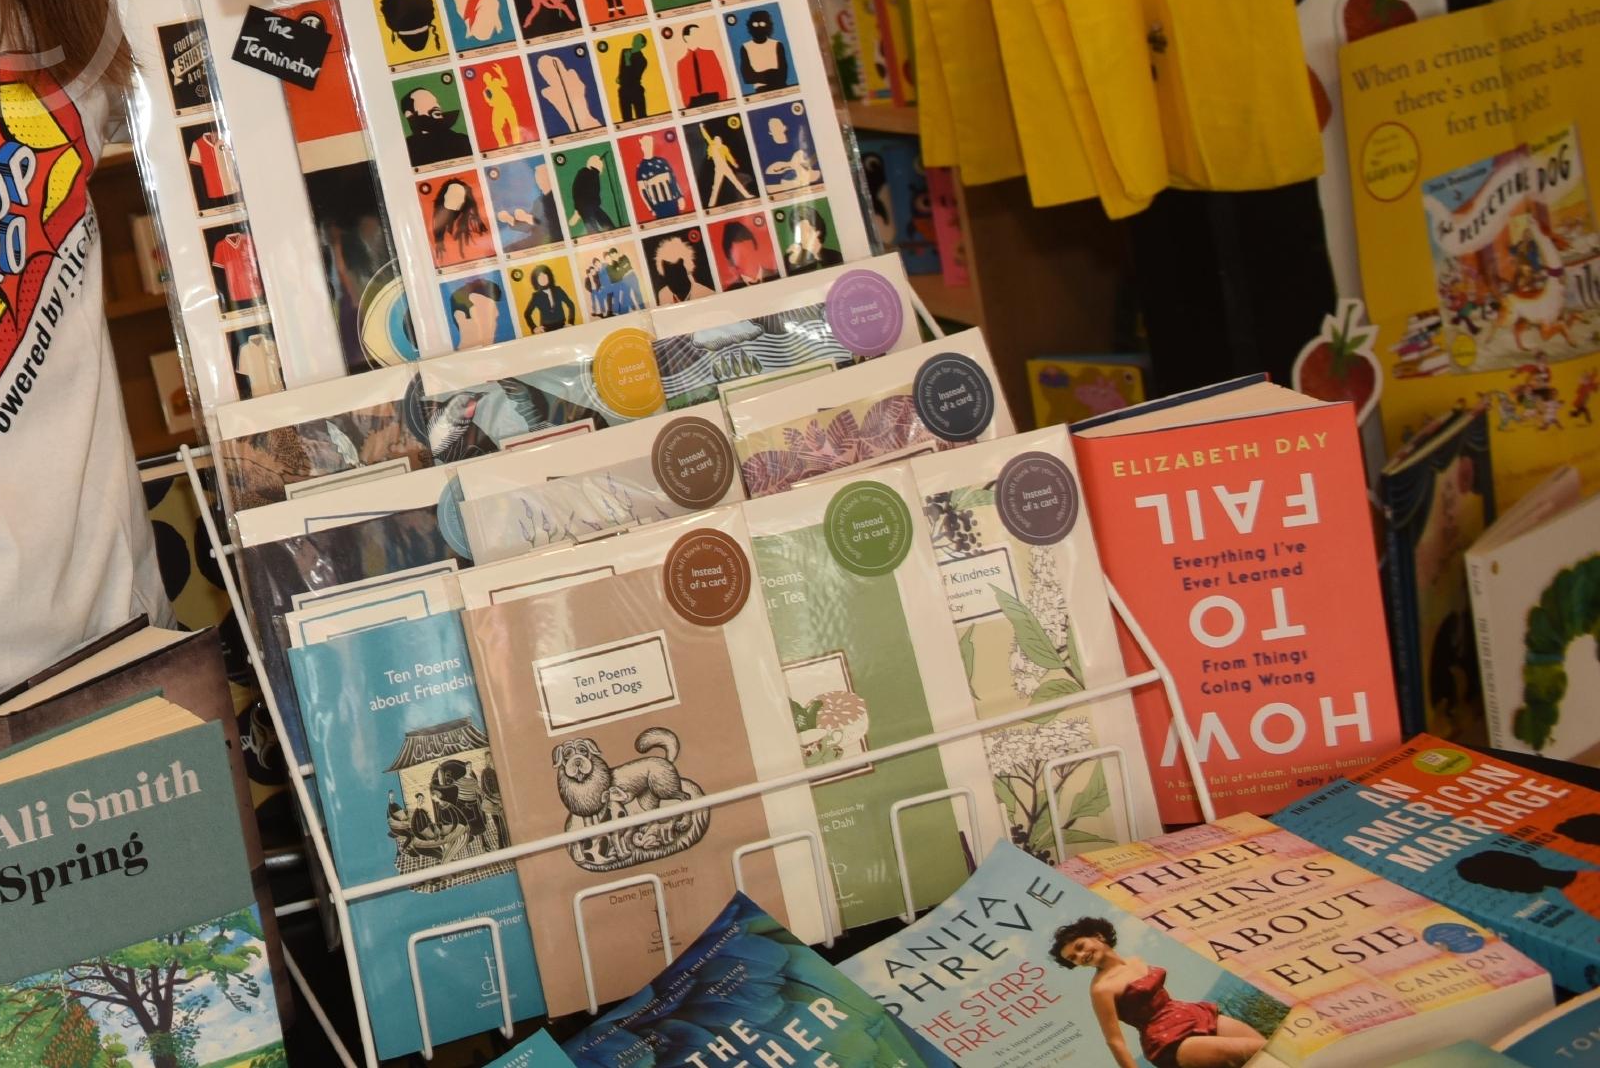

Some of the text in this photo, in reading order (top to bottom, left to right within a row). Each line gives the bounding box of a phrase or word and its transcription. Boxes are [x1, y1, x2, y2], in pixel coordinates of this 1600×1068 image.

[264, 16, 295, 40] The
[241, 35, 321, 79] Terminator
[1351, 62, 1411, 92] When
[1433, 39, 1496, 70] crime
[1394, 78, 1465, 115] there's
[1551, 45, 1585, 70] dog
[1446, 109, 1477, 137] for
[1536, 142, 1571, 194] DOG
[40, 288, 65, 328] by
[617, 360, 646, 375] Instead
[635, 370, 651, 383] card
[938, 383, 966, 400] Instead
[956, 392, 973, 406] card
[678, 447, 707, 467] Instead
[680, 457, 713, 478] of card
[1111, 431, 1329, 478] ELIZABETH DAY
[1022, 484, 1052, 500] Instead
[1022, 495, 1059, 512] of card
[852, 513, 884, 530] Instead
[1134, 472, 1322, 546] FAIL
[701, 541, 713, 550] for
[852, 524, 890, 543] of card
[1172, 540, 1308, 572] Everything I've
[689, 574, 727, 590] of card
[691, 564, 722, 578] Instead
[950, 564, 1002, 585] Kindness
[1181, 562, 1305, 592] Ever Learned
[781, 589, 807, 605] Tea
[1188, 586, 1307, 649] TO
[383, 656, 462, 686] Ten Poems
[573, 663, 638, 689] Ten Poems
[1202, 648, 1309, 675] From Things
[574, 678, 643, 705] about Dogs
[1200, 668, 1317, 698] Going Wrong
[368, 689, 411, 712] about
[1159, 691, 1373, 768] HOW
[1231, 772, 1244, 782] of
[1236, 774, 1325, 797] and Dolly
[1292, 783, 1349, 816] THE NEW YORK
[1356, 778, 1421, 810] AN
[831, 816, 856, 832] Dahl
[1343, 763, 1523, 858] AMERICAN
[1386, 778, 1573, 874] MARRIAGE
[663, 874, 696, 892] Murray
[1106, 840, 1277, 899] THREE
[477, 903, 514, 919] Introduced
[609, 891, 636, 907] Dame
[1141, 861, 1337, 932] THINGS
[884, 895, 1008, 980] ANITA
[1206, 888, 1378, 964] ABOUT
[871, 876, 1066, 1020] SHREVE
[1267, 925, 1418, 988] ELSIE
[690, 956, 707, 972] and
[959, 961, 1046, 1019] STARS
[1282, 950, 1507, 1038] JOANNA CANNON
[942, 983, 1063, 1059] ARE FIRE
[1343, 991, 1437, 1027] SUNDAY TIMES
[684, 1018, 761, 1068] THE
